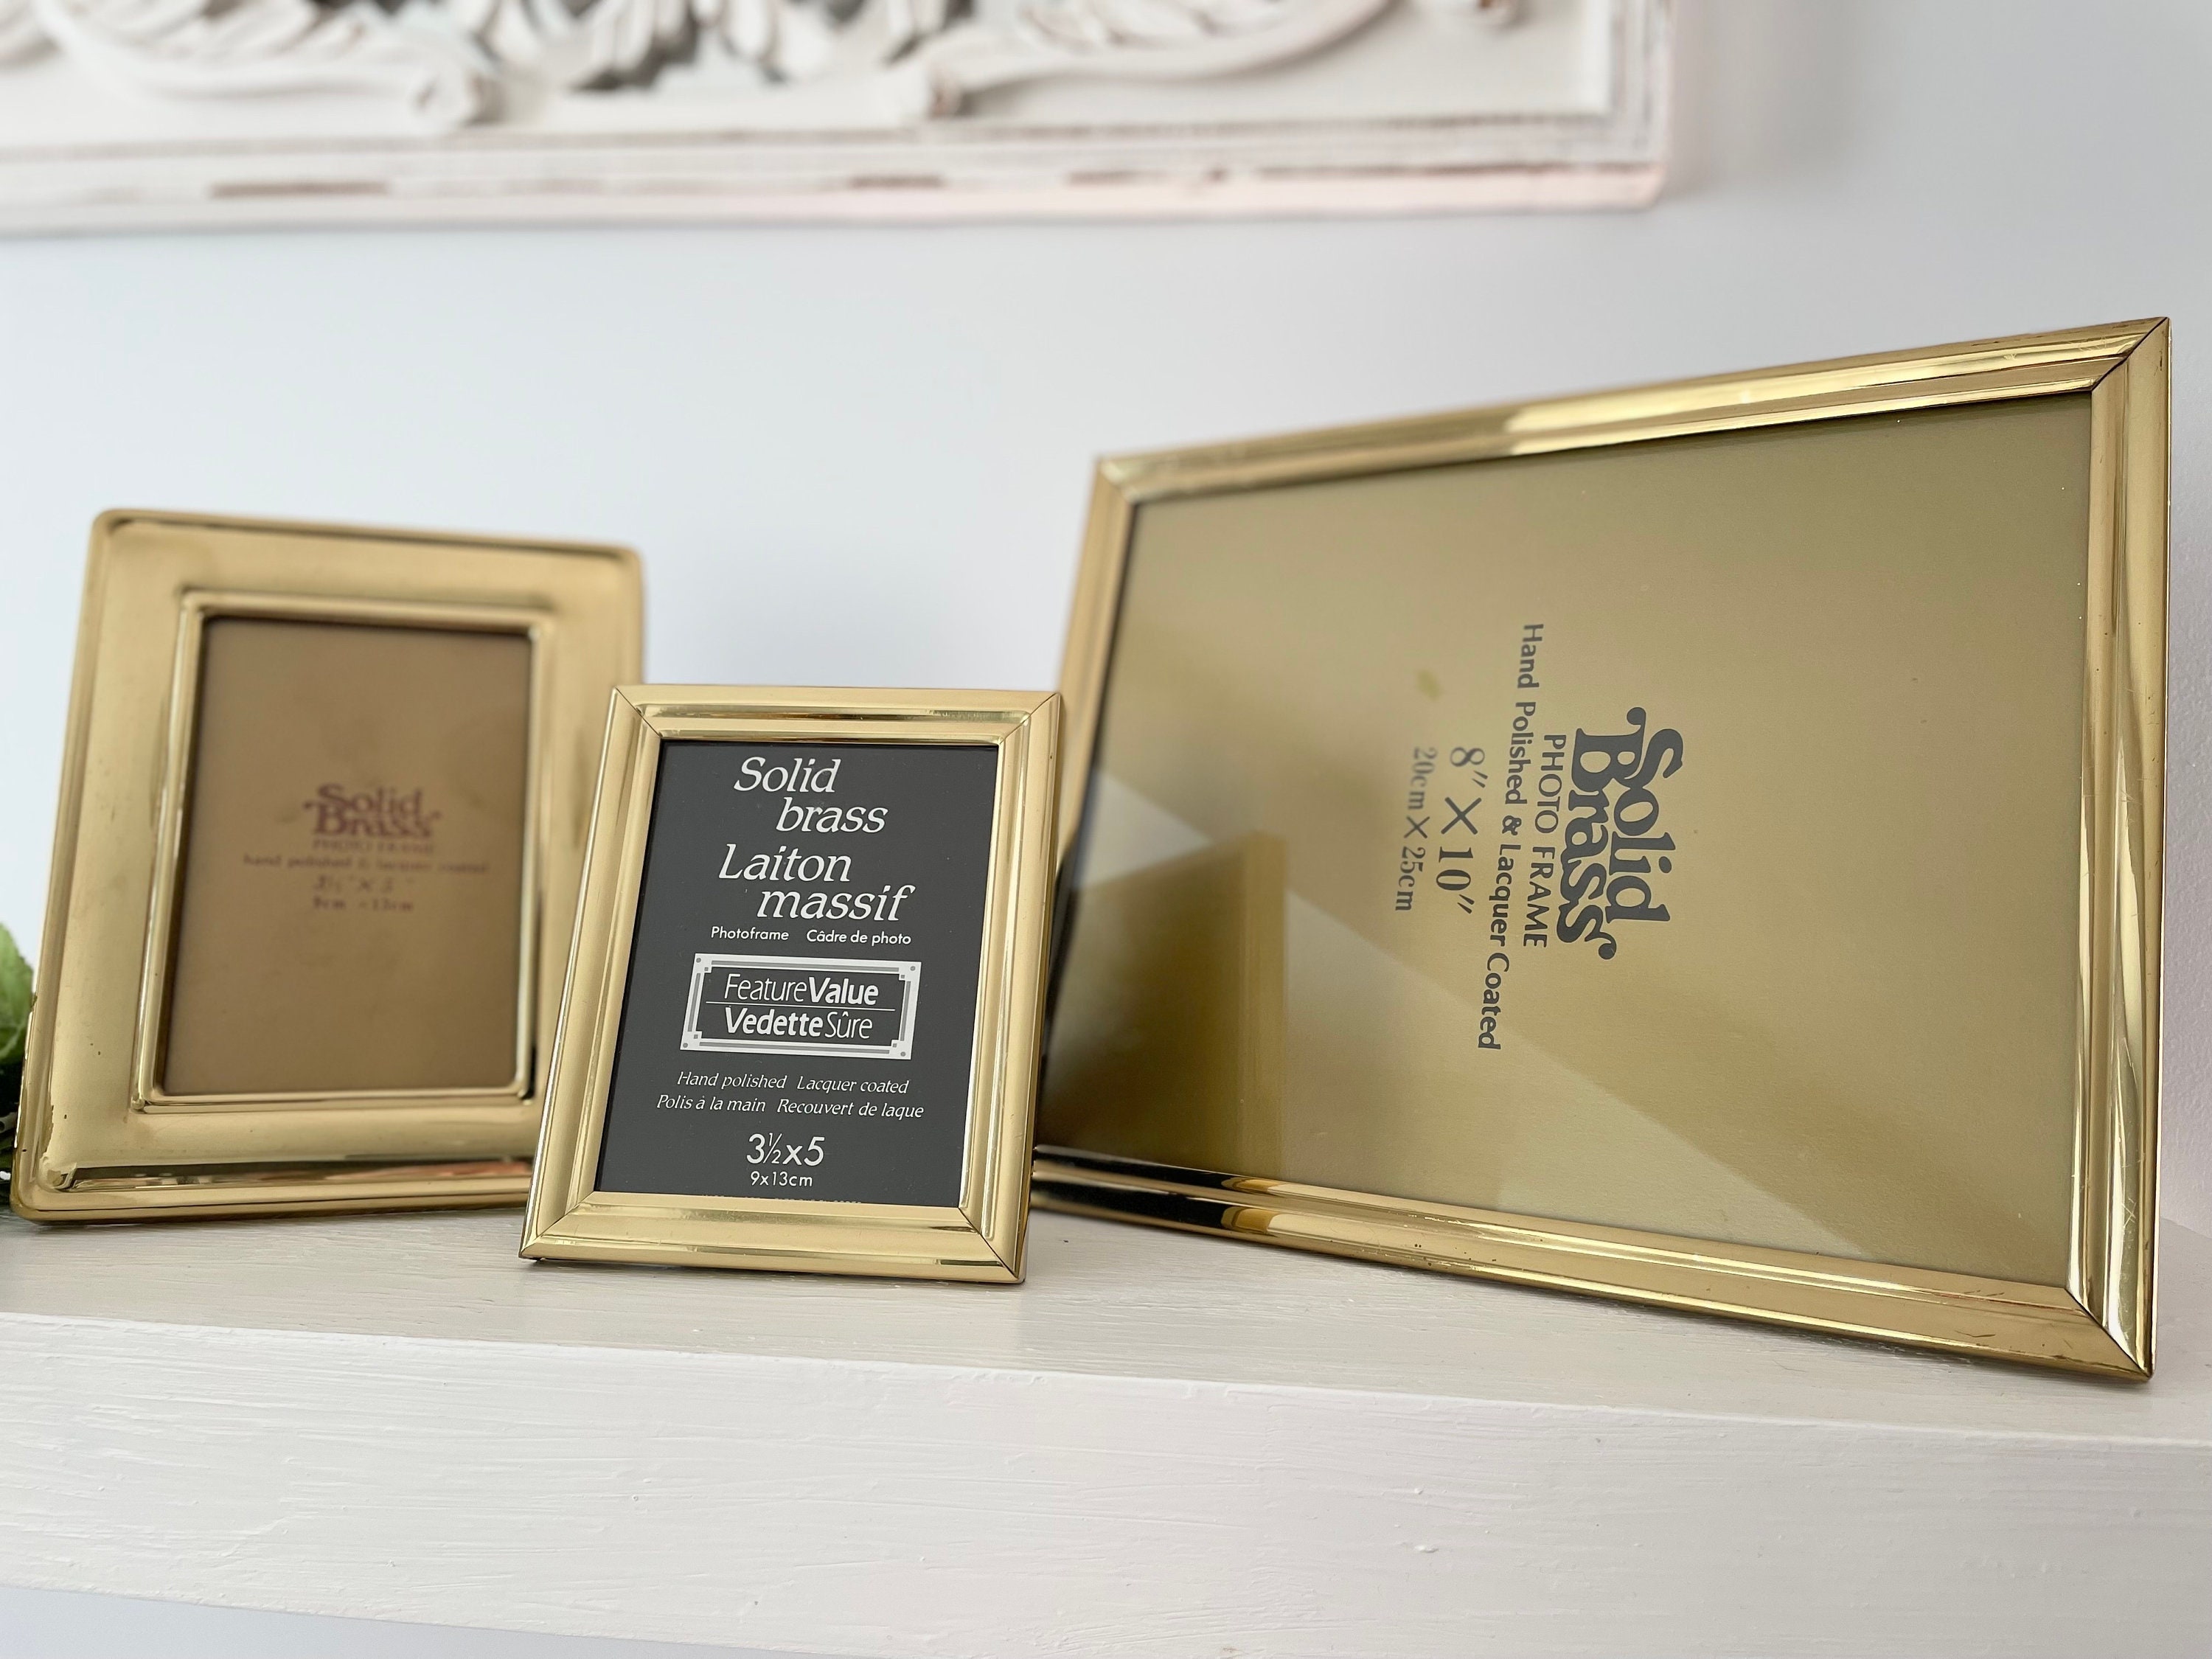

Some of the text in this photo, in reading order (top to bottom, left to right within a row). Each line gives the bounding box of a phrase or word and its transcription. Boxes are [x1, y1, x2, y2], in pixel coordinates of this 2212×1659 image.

[734, 757, 841, 793] Solid
[317, 783, 422, 815] Solid
[776, 797, 888, 833] brass
[1478, 623, 1544, 1049] Hand Polished & Lacquer Coated
[1523, 734, 1567, 947] PHOTO FRAME
[1557, 707, 1646, 959] Brass
[1604, 728, 1683, 924] Solid
[719, 844, 852, 882] Laiton
[1396, 846, 1426, 911] 25cm
[757, 885, 916, 921] massif
[711, 926, 911, 947] Photoframe Câdre de photo
[677, 1071, 909, 1094] Hand polished Lacquer coated
[657, 1095, 924, 1121] Polis à la main Recouvert de laque
[751, 1171, 813, 1187] 9x13cm
